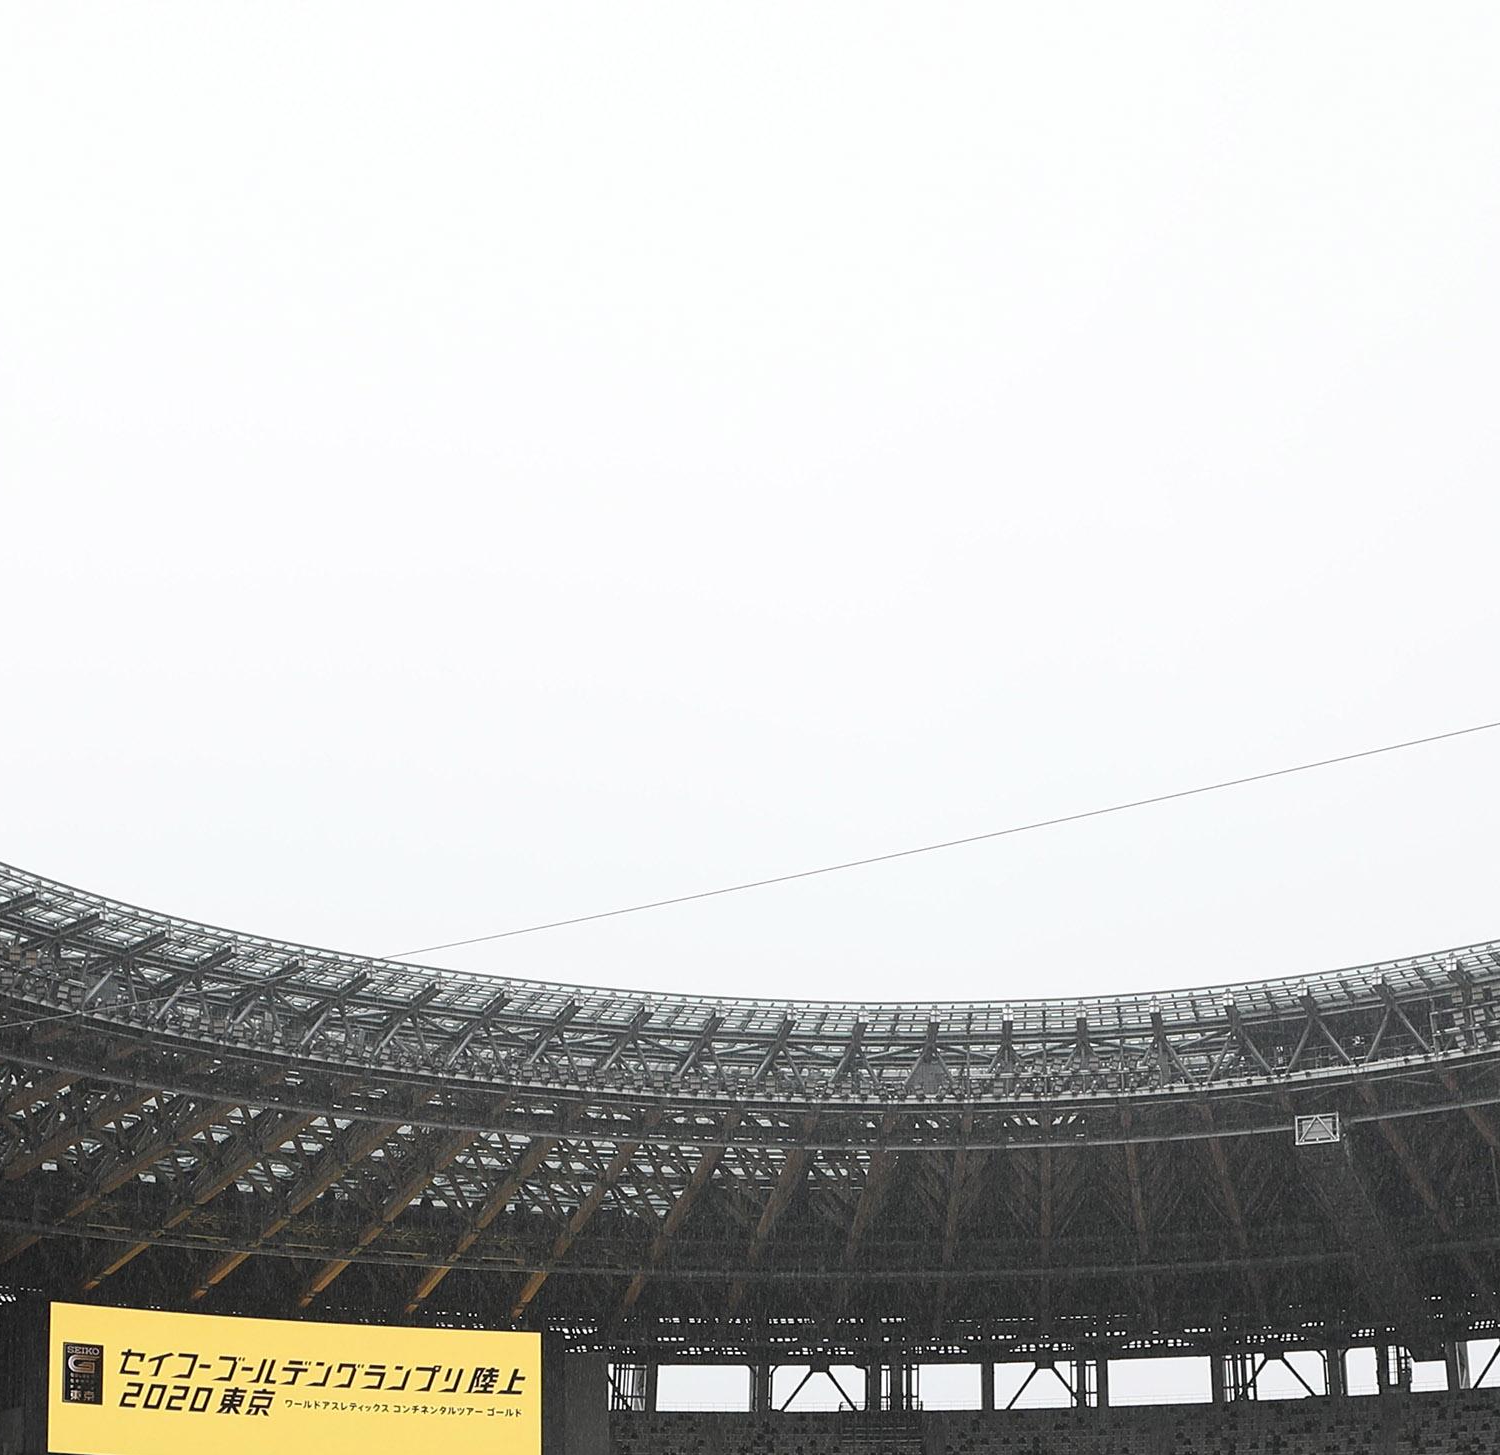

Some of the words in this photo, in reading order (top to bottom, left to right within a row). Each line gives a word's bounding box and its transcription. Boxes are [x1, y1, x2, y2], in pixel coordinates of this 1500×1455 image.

[67, 1345, 100, 1356] SEIKO
[119, 1348, 526, 1396] セイコーゴールデングランプリ陸上
[119, 1381, 213, 1413] 2020
[216, 1387, 276, 1417] 東京
